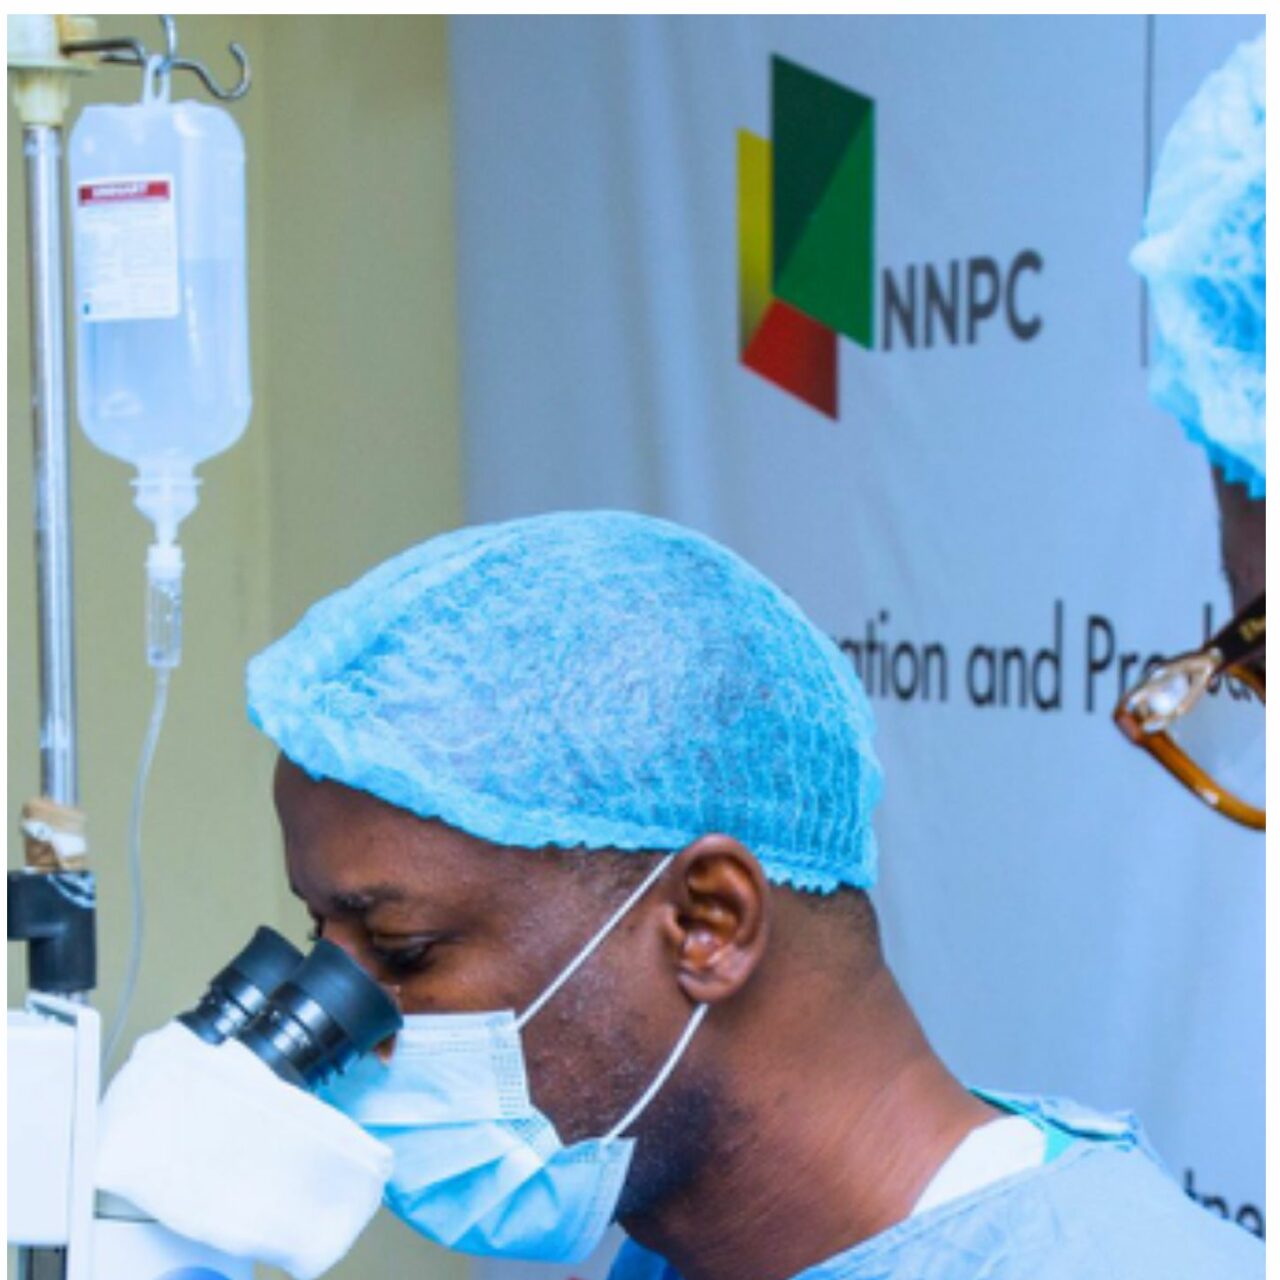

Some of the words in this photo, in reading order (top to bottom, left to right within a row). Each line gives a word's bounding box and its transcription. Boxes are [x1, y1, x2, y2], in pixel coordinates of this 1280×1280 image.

[882, 249, 1043, 351] NNPC
[835, 609, 948, 702] ation
[966, 599, 1062, 711] and
